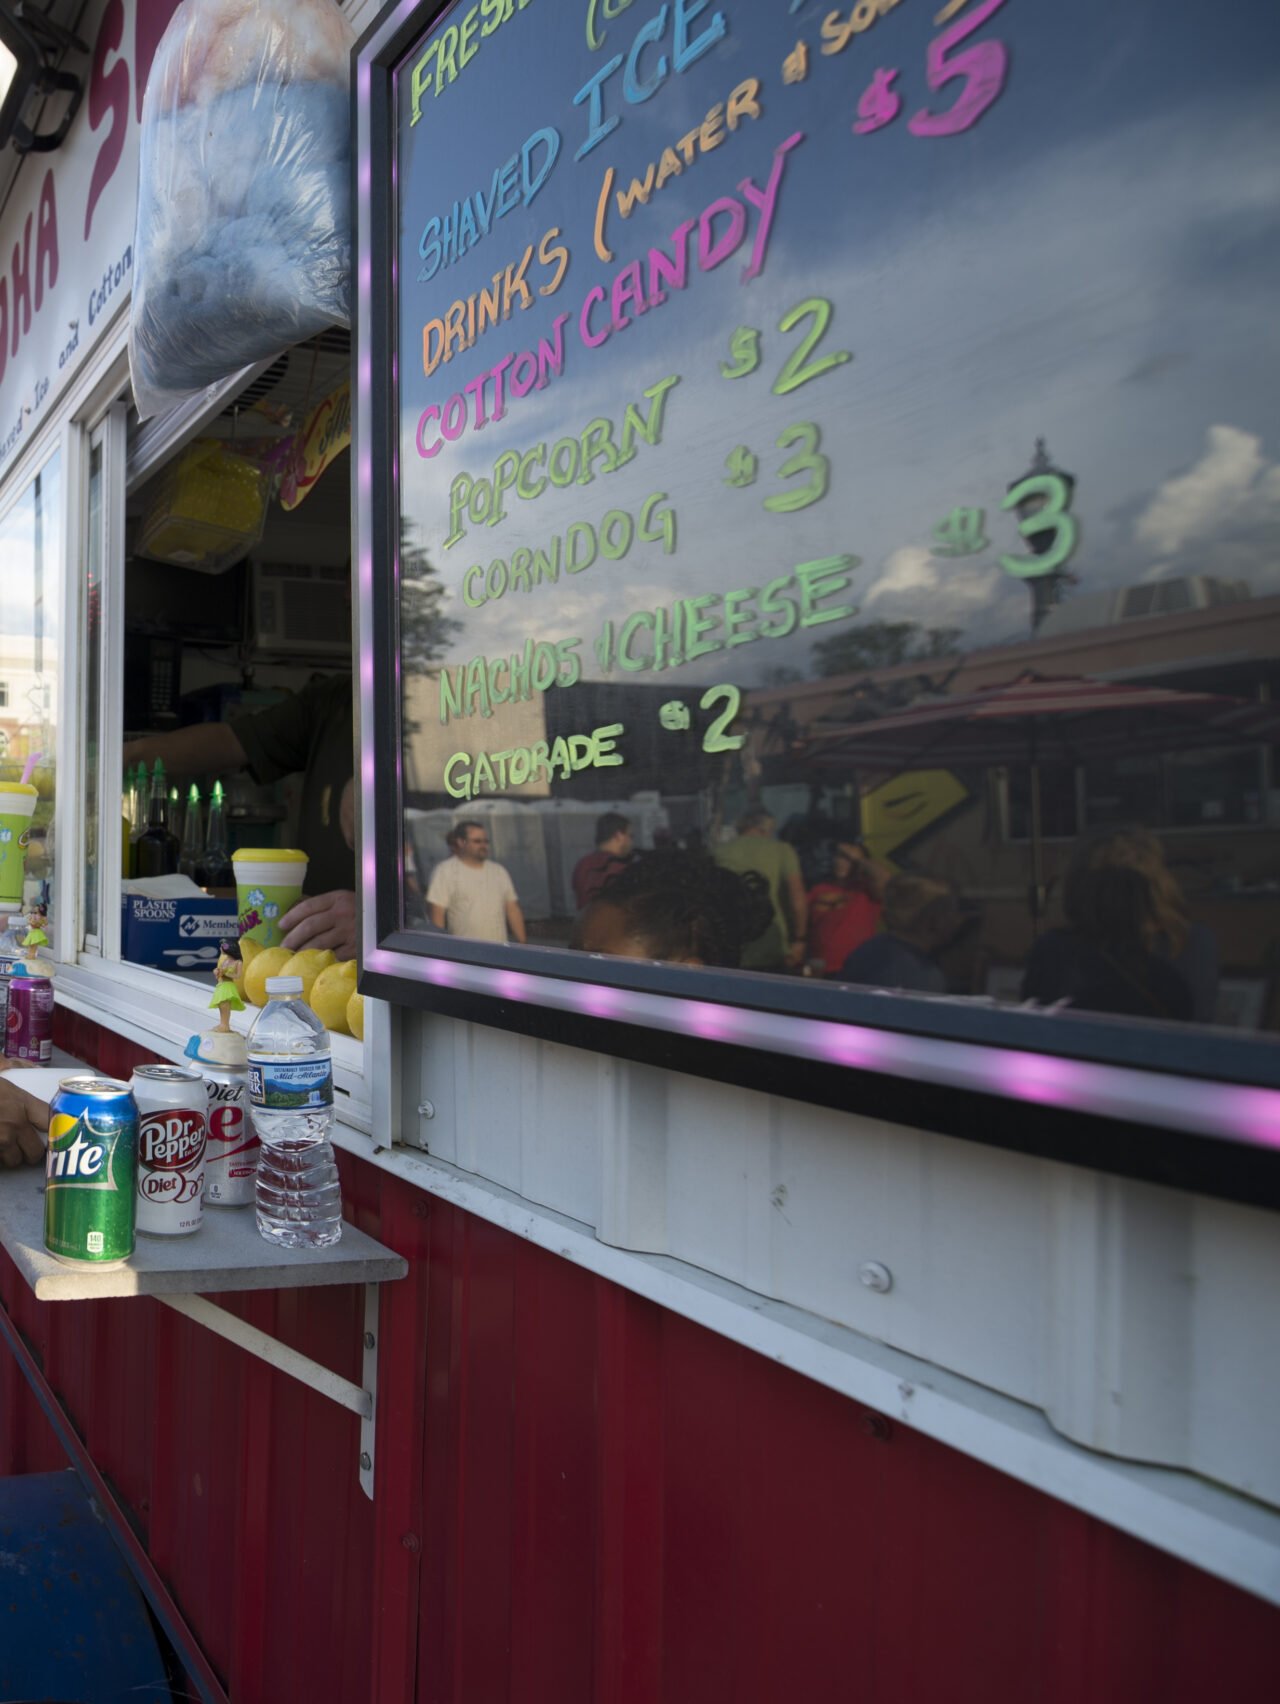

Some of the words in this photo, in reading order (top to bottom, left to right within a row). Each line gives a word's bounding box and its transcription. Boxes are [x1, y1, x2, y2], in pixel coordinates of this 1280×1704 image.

[416, 312, 569, 458] COTTON
[579, 131, 803, 348] CANDY
[853, 0, 1008, 137] $5
[417, 126, 560, 282] SHAVED
[59, 318, 80, 369] and
[88, 245, 132, 326] Cotton
[423, 227, 569, 377] DRINKS
[443, 375, 681, 550] POPCORN
[719, 297, 852, 394] $2
[463, 491, 677, 608] CORNDOG
[722, 420, 830, 512] $3
[440, 637, 582, 725] NACHOS
[620, 553, 859, 672] CHEESE
[444, 722, 624, 800] GATORADE
[133, 900, 177, 910] PLASTIC
[134, 909, 176, 918] SPOONS
[165, 1118, 194, 1142] Dr
[205, 1079, 244, 1102] Diet
[140, 1122, 205, 1164] Pepper
[148, 1177, 178, 1194] Diet
